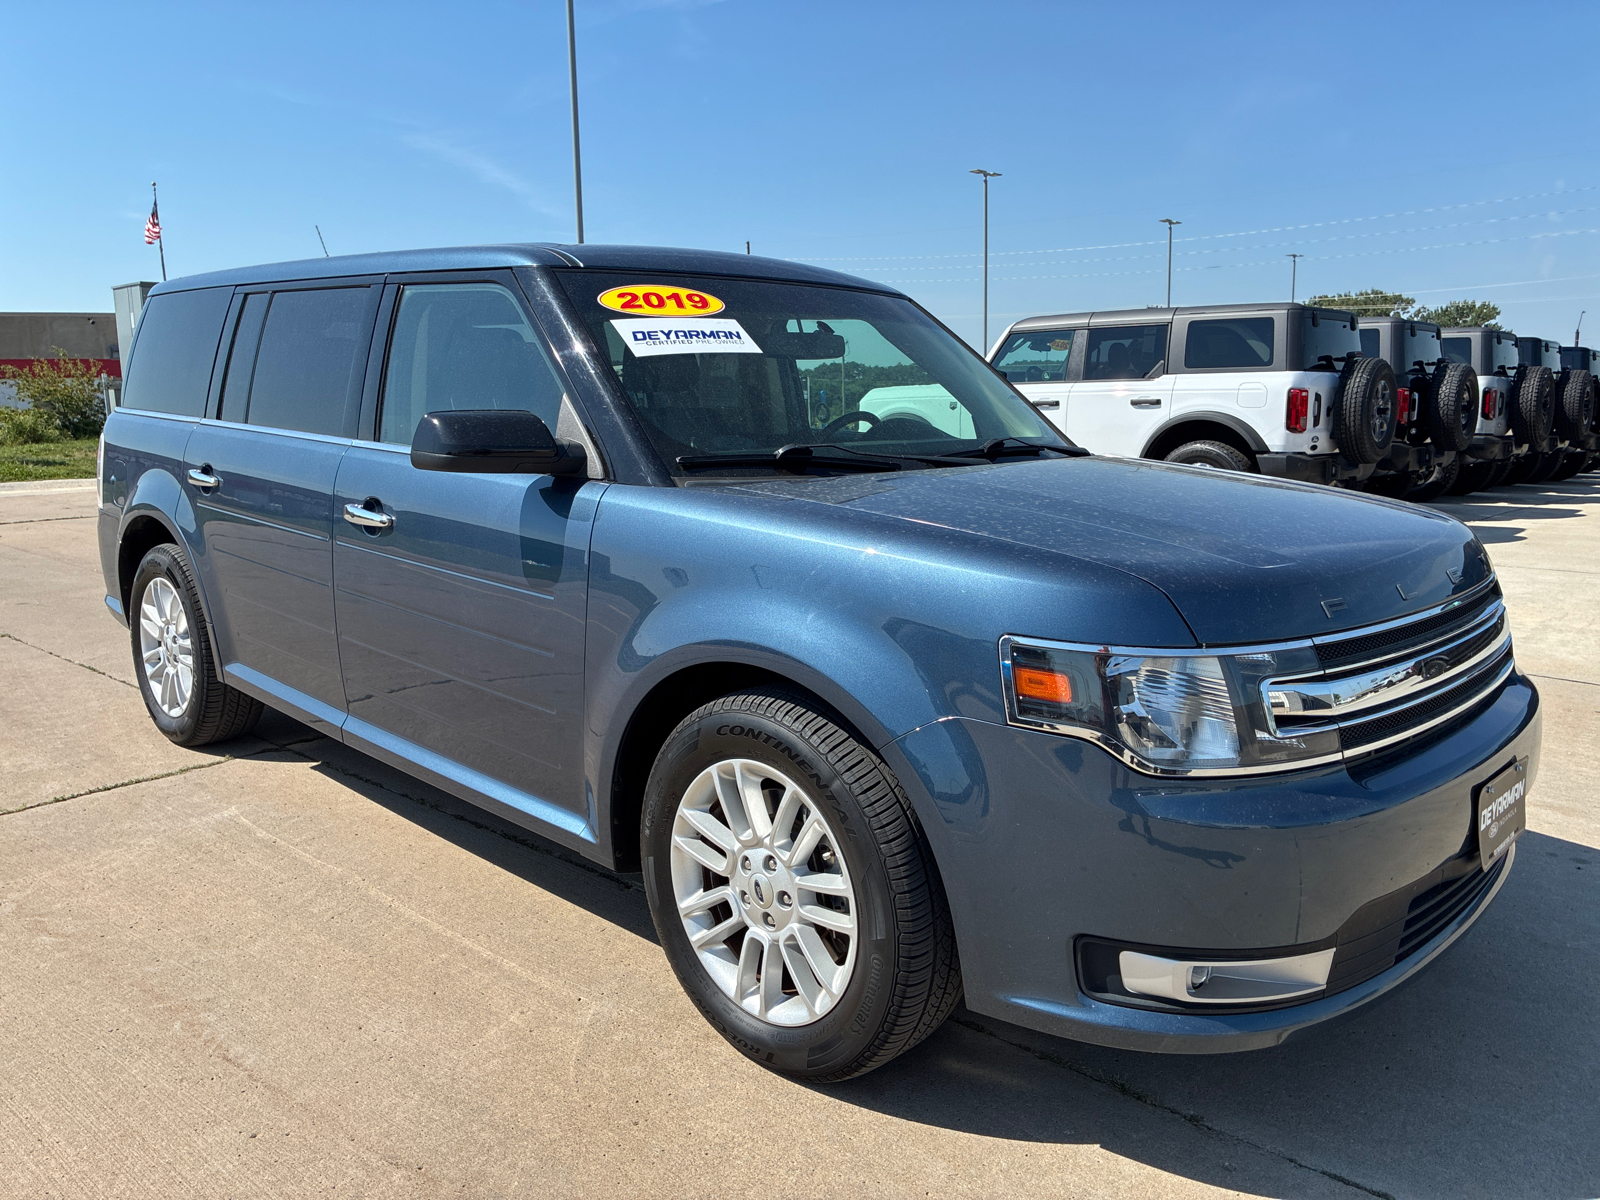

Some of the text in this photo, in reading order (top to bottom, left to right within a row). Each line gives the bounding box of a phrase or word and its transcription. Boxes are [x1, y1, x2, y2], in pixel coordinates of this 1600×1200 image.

[616, 291, 711, 310] 2019
[632, 329, 742, 341] DEYARMAN
[645, 339, 693, 347] CERTIFIED
[716, 724, 858, 842] CONTINENTAL
[1480, 778, 1525, 832] DEYARMAN
